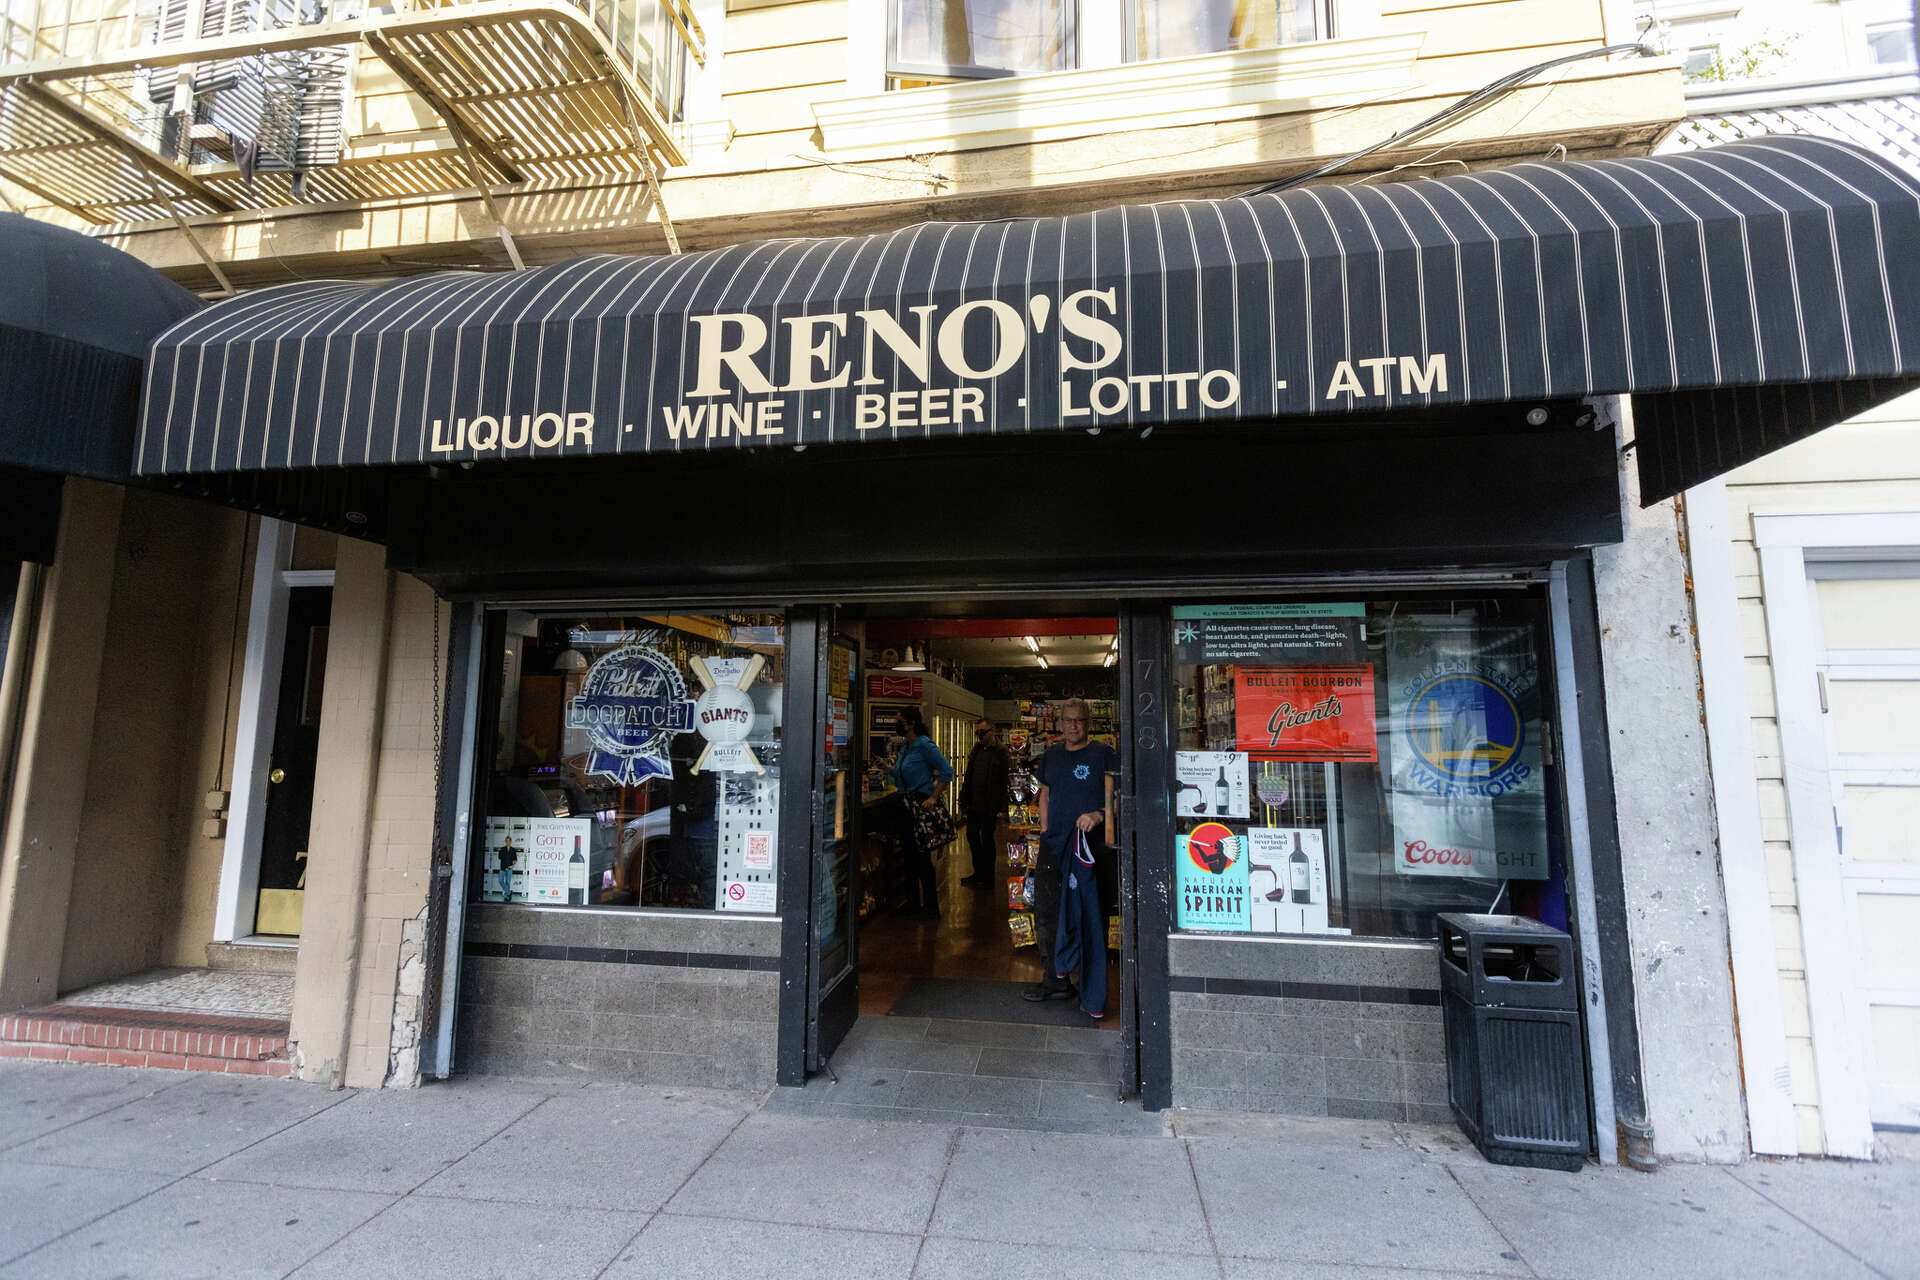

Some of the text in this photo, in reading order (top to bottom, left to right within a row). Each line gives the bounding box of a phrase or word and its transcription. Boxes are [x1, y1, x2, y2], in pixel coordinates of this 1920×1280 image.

[685, 287, 1122, 397] RENO'S
[431, 353, 1448, 452] LIQUOR WINE BEER LOTTO ATM
[1218, 624, 1250, 632] cigarettes
[1294, 624, 1310, 632] lung
[1248, 641, 1269, 649] lights,
[1229, 650, 1261, 658] cigarette.
[1247, 676, 1362, 687] BULLEIT BOURBON
[1474, 663, 1522, 699] STATE
[572, 704, 681, 727] DOGPATCH
[701, 707, 749, 724] GIANTS
[1267, 694, 1344, 747] Giants
[1408, 760, 1532, 800] WARRIORS
[536, 834, 566, 846] GOTT
[536, 851, 566, 861] GOOD
[1404, 840, 1472, 866] Coors
[1184, 876, 1242, 884] NATURAL
[1184, 885, 1243, 894] AMERICAN
[1185, 895, 1243, 913] SPIRIT
